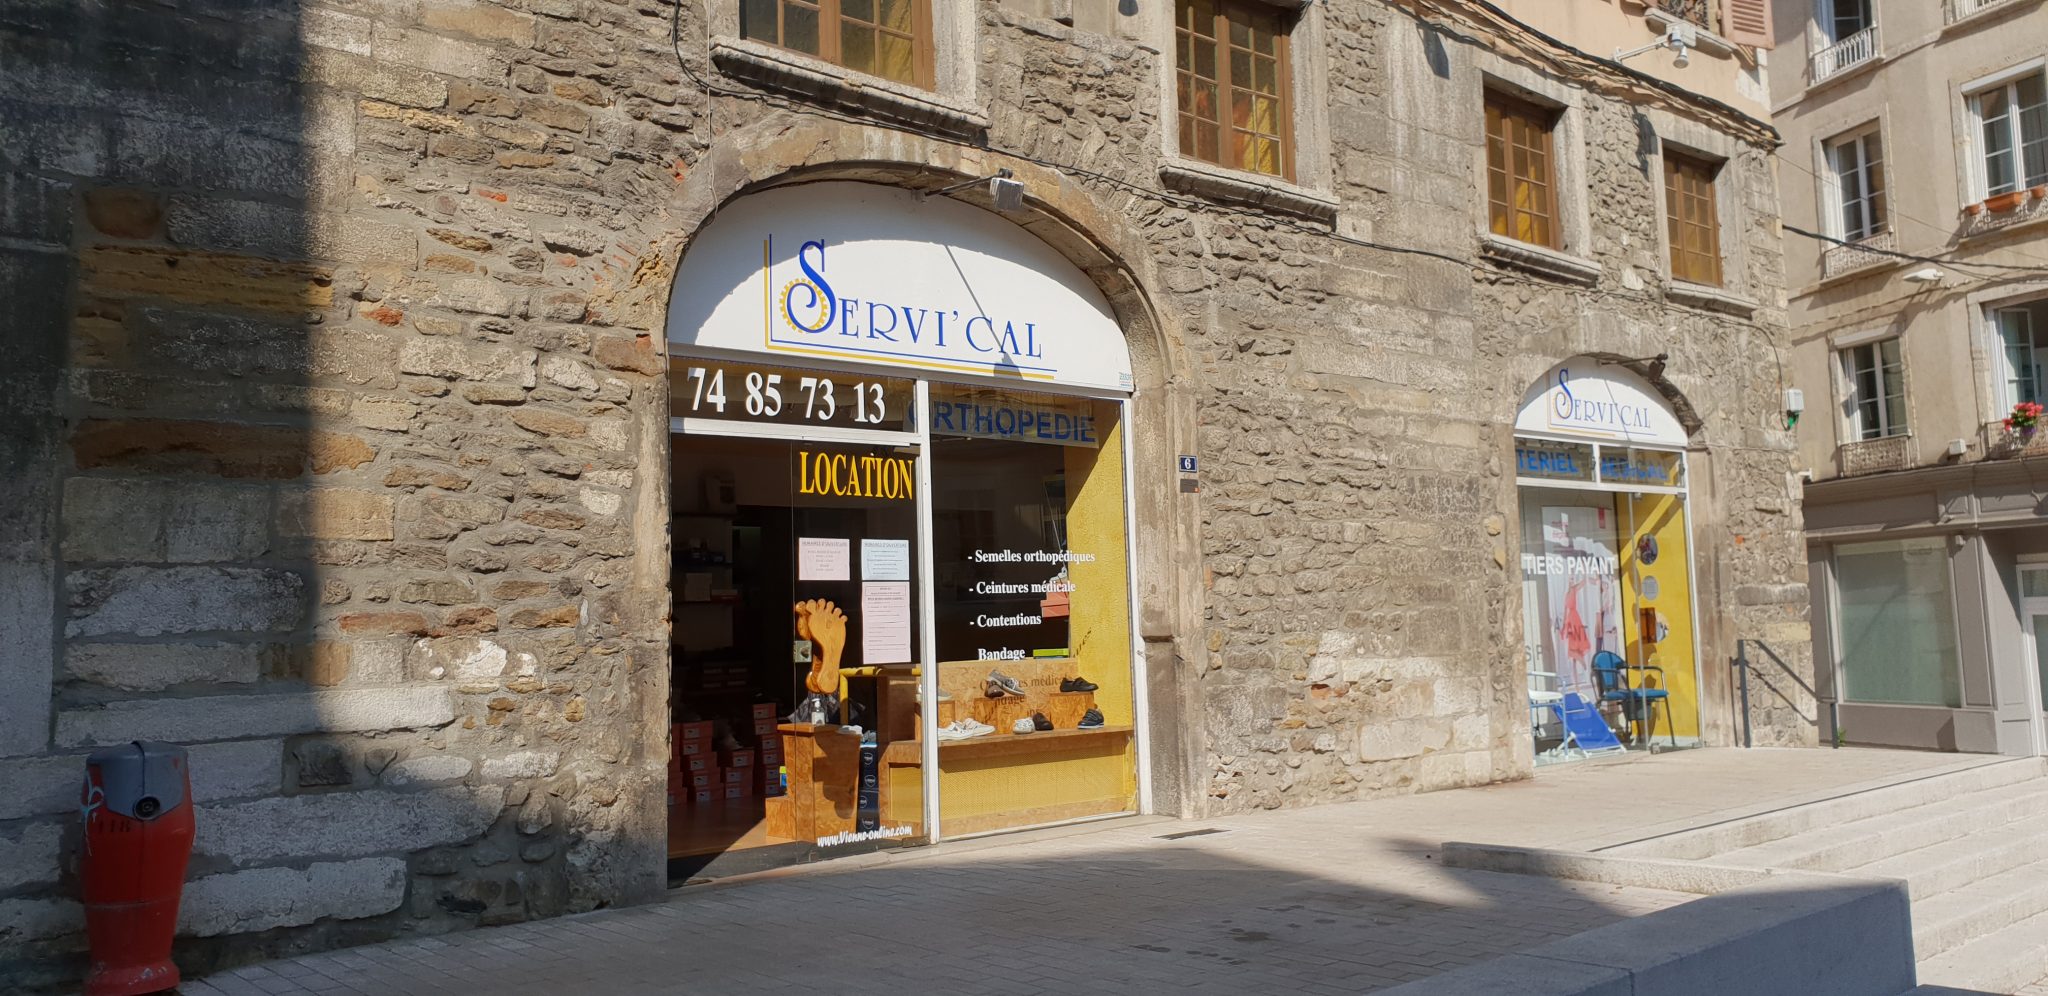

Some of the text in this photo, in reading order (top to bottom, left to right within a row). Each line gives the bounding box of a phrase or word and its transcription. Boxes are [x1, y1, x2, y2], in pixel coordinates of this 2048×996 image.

[786, 238, 1043, 359] SERVI'CAL
[687, 367, 886, 424] 74 85 73 13
[1184, 458, 1192, 470] 6
[800, 451, 913, 500] LOCATION
[975, 549, 1022, 563] Semelles
[1023, 549, 1096, 565] orthopédiques
[1524, 556, 1615, 575] TIERS PAYANT
[976, 581, 1029, 594] Ceintures
[1031, 580, 1076, 593] médicale
[977, 613, 1042, 627] Contentions
[978, 647, 1026, 661] Bandage
[817, 825, 912, 847] www.Vienne-online.com
